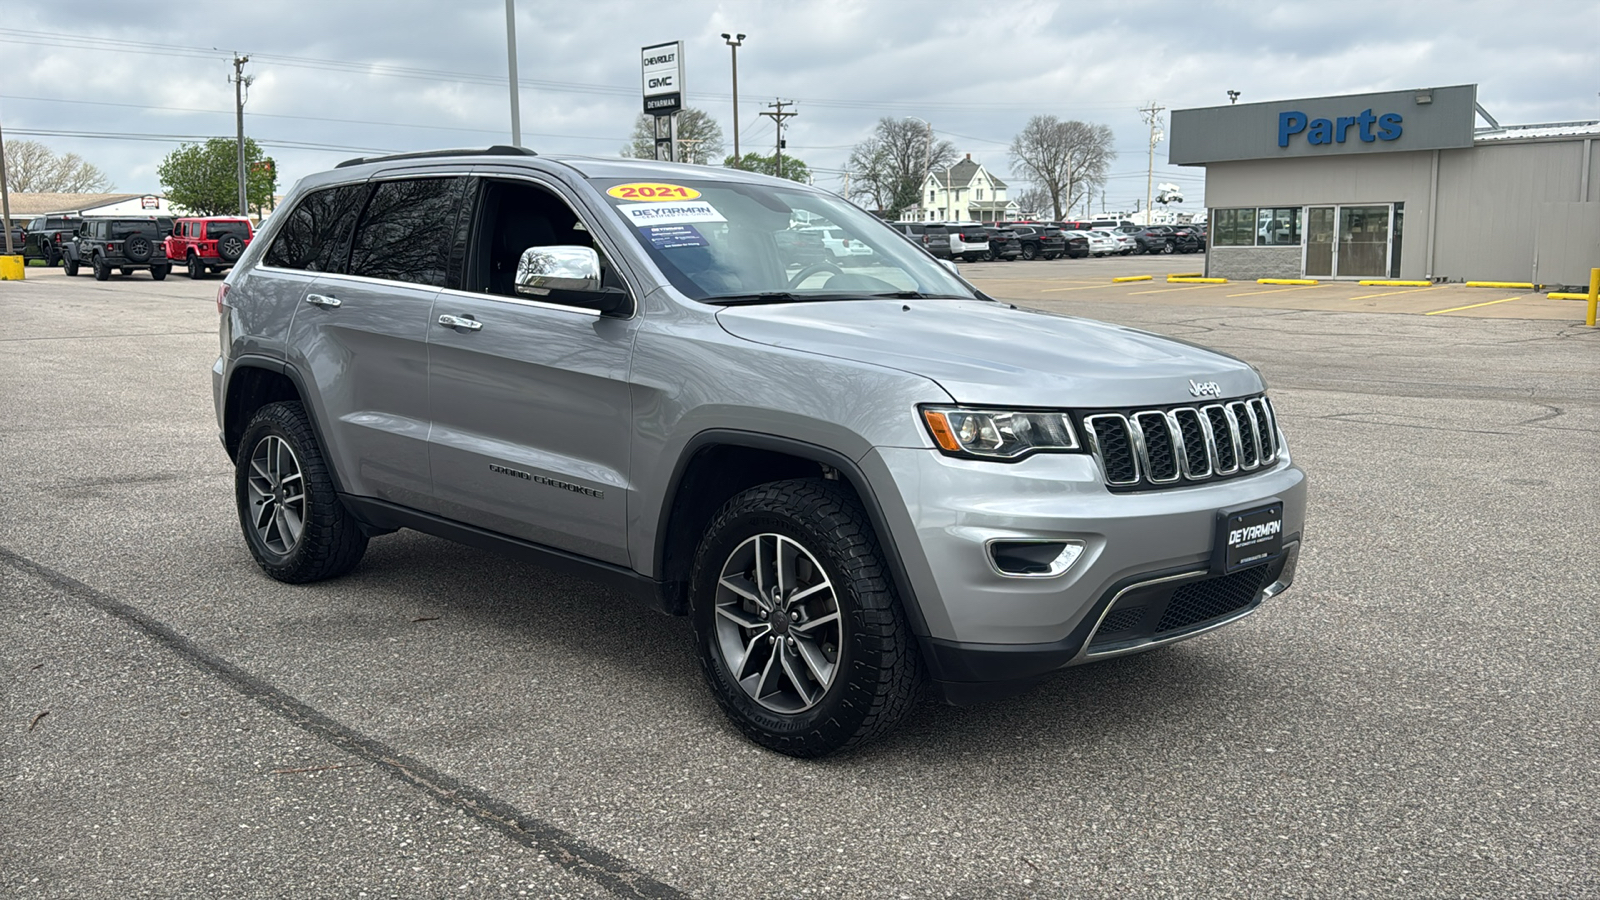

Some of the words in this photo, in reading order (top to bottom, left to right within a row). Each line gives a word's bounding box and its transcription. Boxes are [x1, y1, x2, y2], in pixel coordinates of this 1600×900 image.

[643, 53, 676, 67] CHEVROLET
[648, 76, 673, 89] GMC
[647, 98, 676, 109] DEYARMAN
[1278, 108, 1404, 147] Parts
[619, 186, 689, 198] 2021
[631, 207, 712, 217] DEYARMAN
[1188, 379, 1221, 398] Jeep
[489, 463, 531, 480] GRAND
[534, 475, 605, 500] CHEROKEE
[1228, 519, 1282, 546] DEYARMAN
